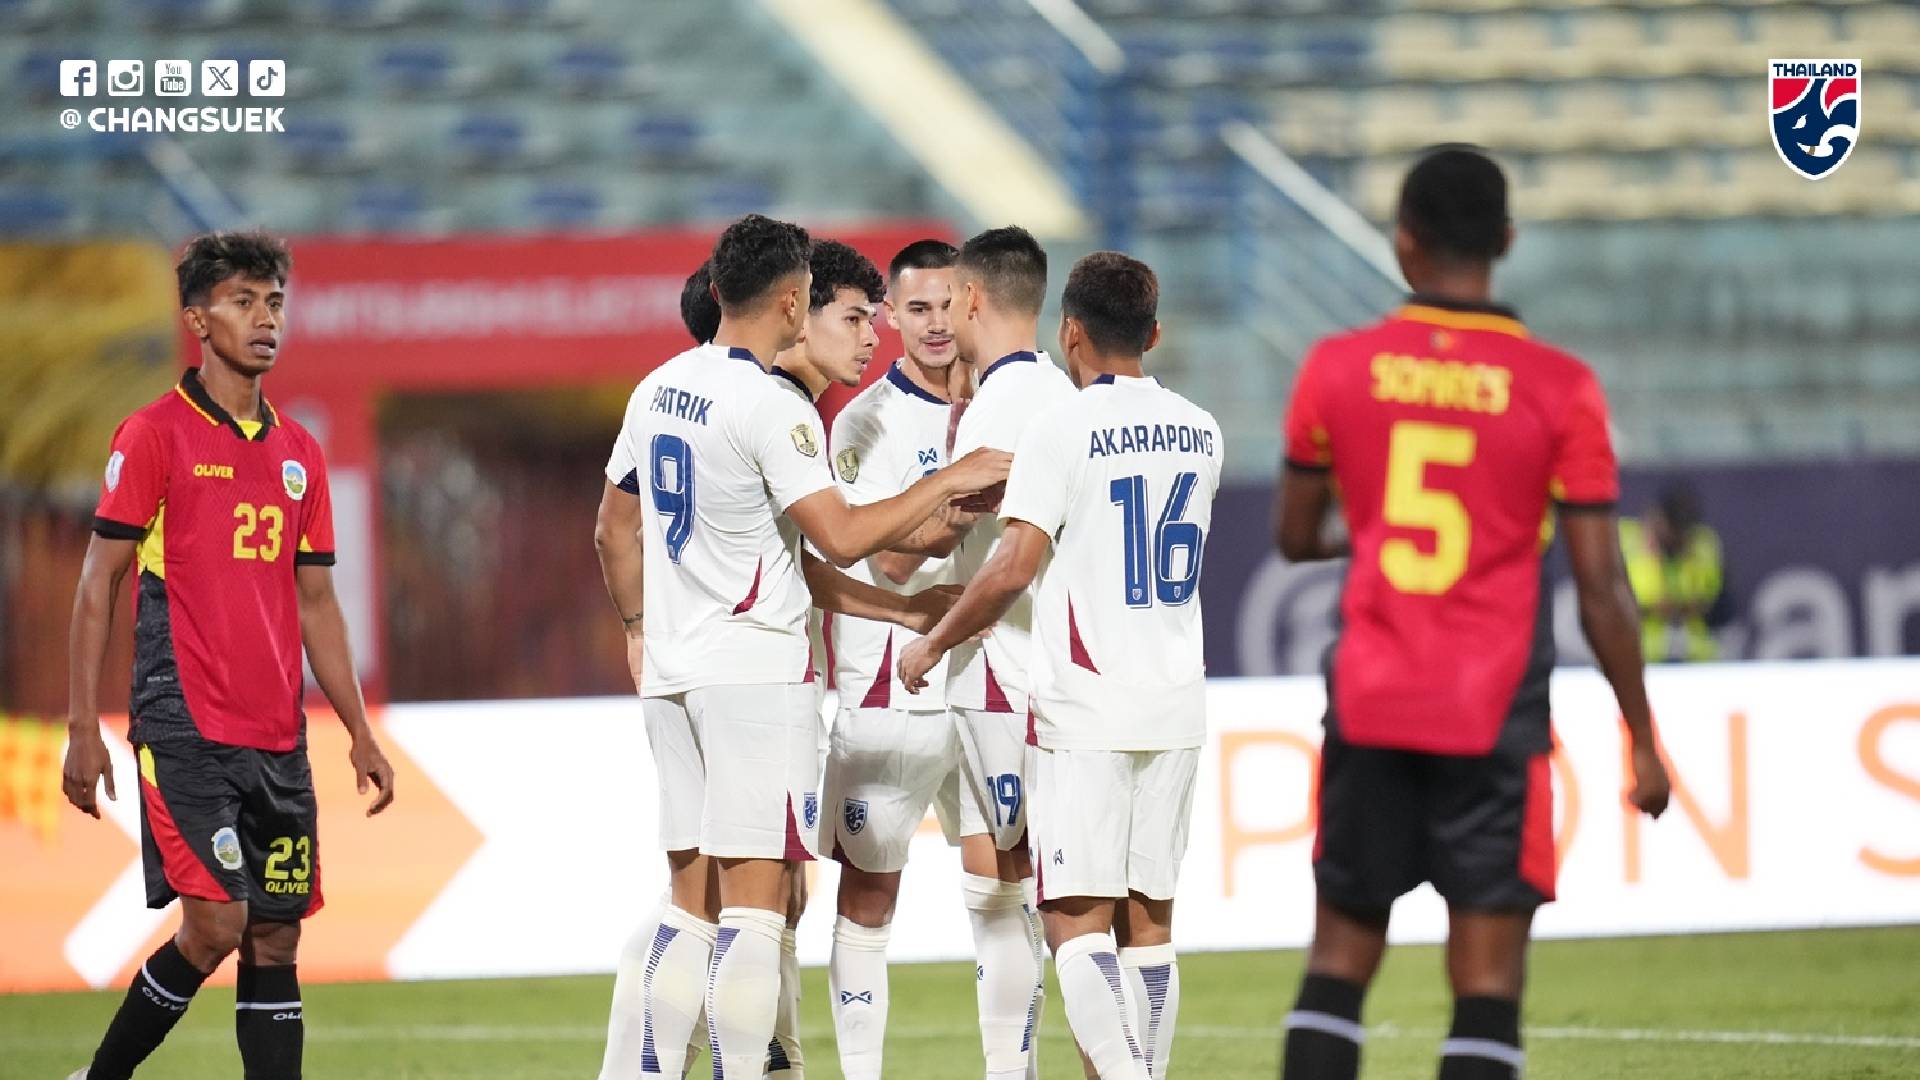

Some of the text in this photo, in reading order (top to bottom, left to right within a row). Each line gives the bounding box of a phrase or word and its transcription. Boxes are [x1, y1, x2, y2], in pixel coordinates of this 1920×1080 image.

[650, 385, 713, 426] PATRIK
[1089, 424, 1213, 458] AKARAPONG
[193, 463, 234, 479] OLIVER
[651, 433, 695, 565] 9
[1379, 420, 1477, 595] 5
[232, 502, 283, 562] 23
[1109, 471, 1204, 609] 16
[987, 773, 1021, 827] 19
[265, 836, 310, 881] 23
[265, 881, 309, 894] OLIVER
